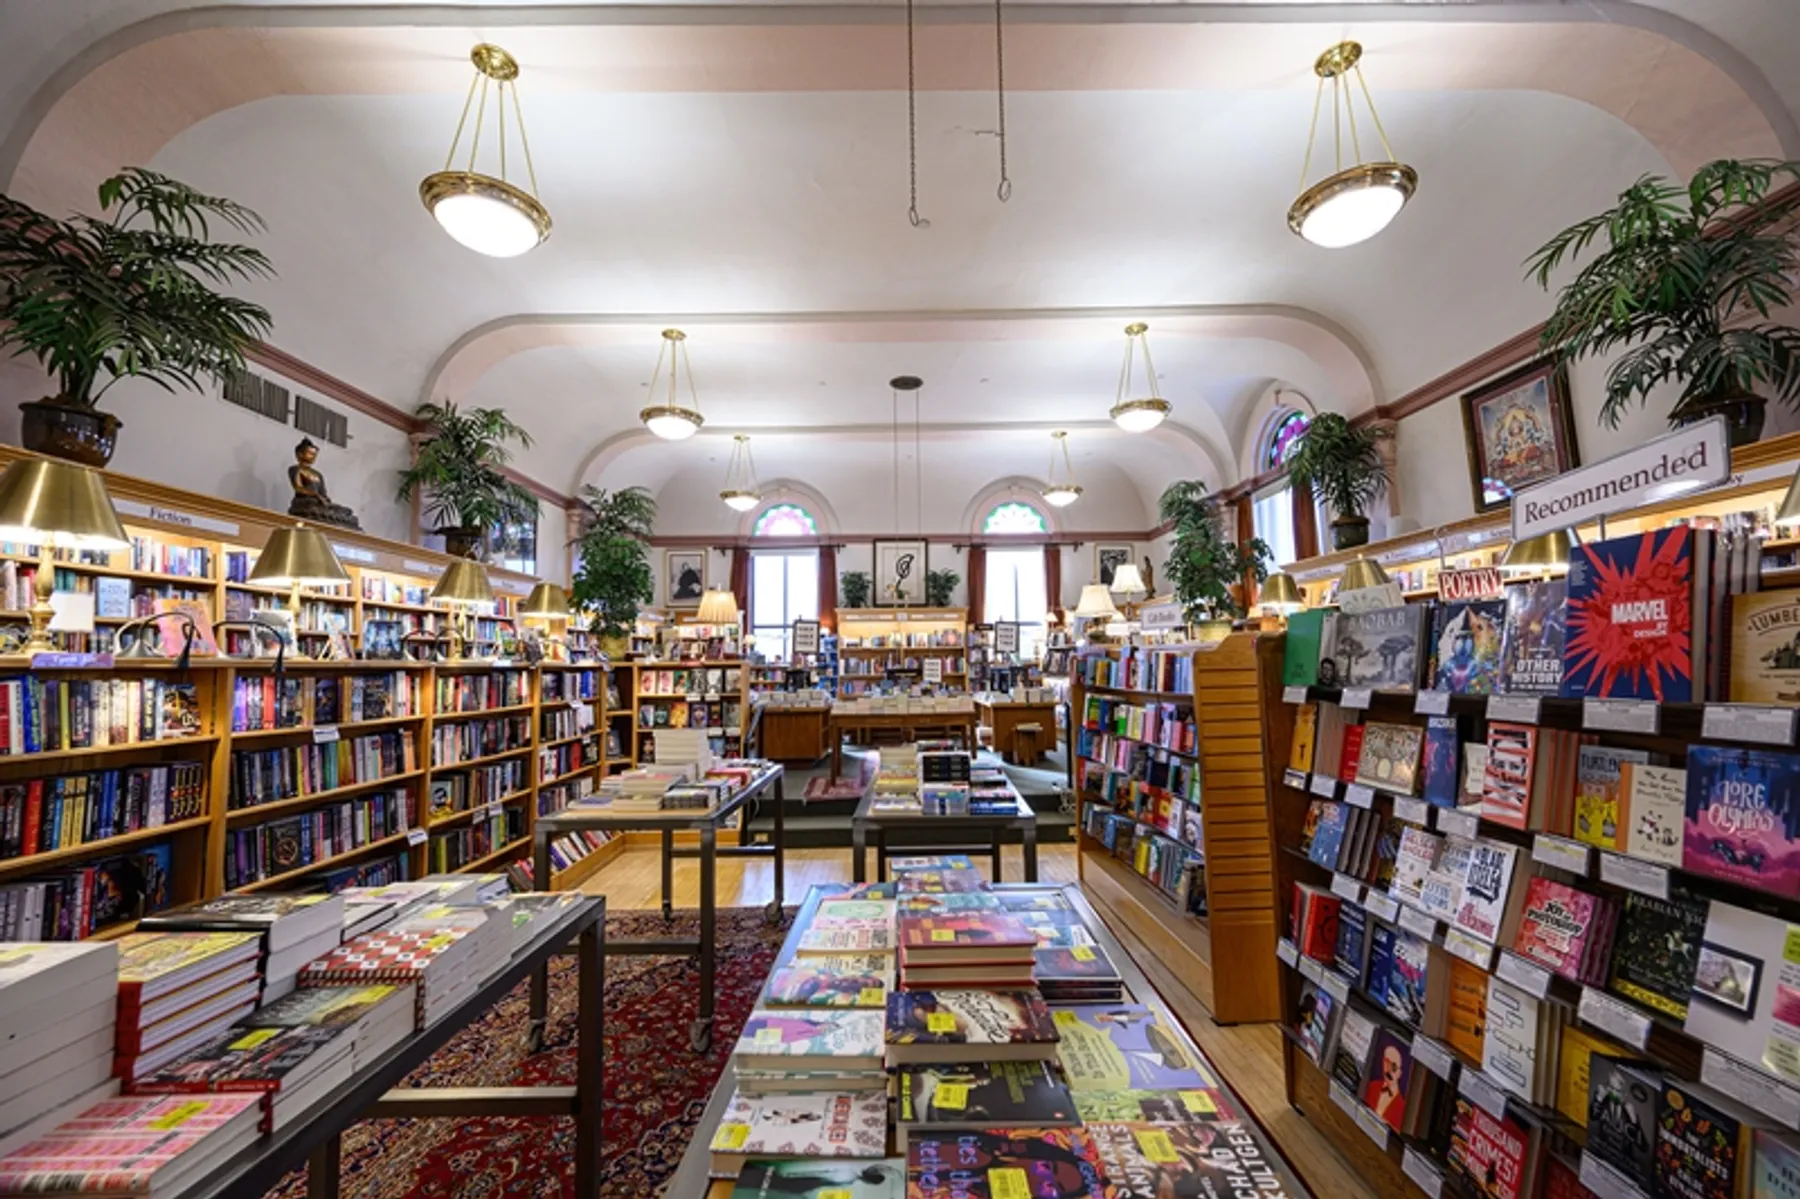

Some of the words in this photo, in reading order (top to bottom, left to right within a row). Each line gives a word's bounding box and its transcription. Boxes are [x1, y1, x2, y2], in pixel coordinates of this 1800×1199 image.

[1524, 442, 1708, 524] Recommended
[150, 507, 192, 525] Fiction
[1440, 570, 1499, 598] POETRY
[1349, 611, 1406, 630] BAOBAB
[1611, 601, 1669, 624] MARVEL
[1511, 672, 1564, 684] HISTORY
[1516, 659, 1560, 671] OTHER
[957, 1135, 981, 1165] ties
[1089, 1124, 1133, 1199] STRANGE
[1110, 1124, 1157, 1199] ANIMALS
[1225, 1122, 1286, 1199] KULTGEN
[1211, 1147, 1259, 1199] CHAD
